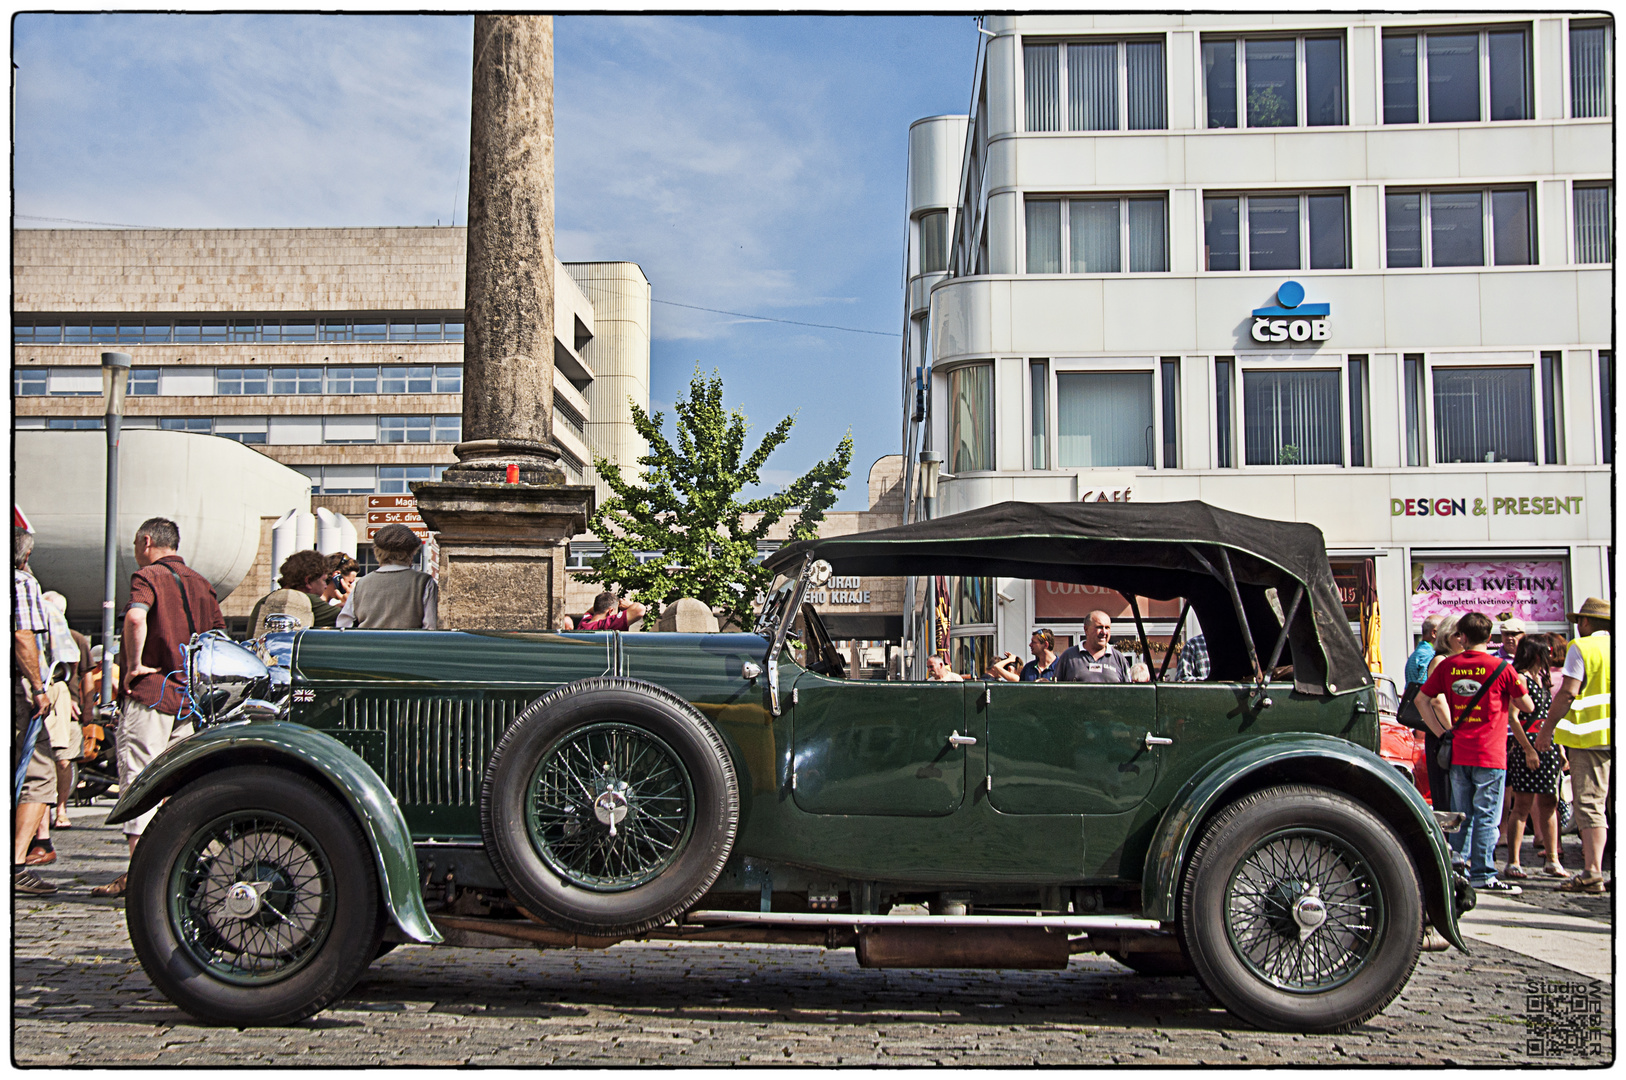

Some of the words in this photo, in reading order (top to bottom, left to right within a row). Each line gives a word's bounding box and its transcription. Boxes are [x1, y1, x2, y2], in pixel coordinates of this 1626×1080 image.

[1251, 317, 1332, 342] ČSOB
[1082, 487, 1132, 502] CAFÉ
[1390, 498, 1466, 516] DESIGN
[1472, 498, 1487, 516] &
[1493, 496, 1583, 515] PRESENT
[385, 513, 402, 522] Svč.
[1416, 577, 1475, 592] ANGEL
[1482, 574, 1558, 591] KVĚTINY
[831, 591, 871, 604] KRAJE
[1437, 597, 1477, 606] kompletní
[1477, 597, 1515, 606] květinový
[1516, 597, 1538, 605] servis
[1450, 667, 1473, 676] Jawa
[1475, 667, 1486, 676] 20
